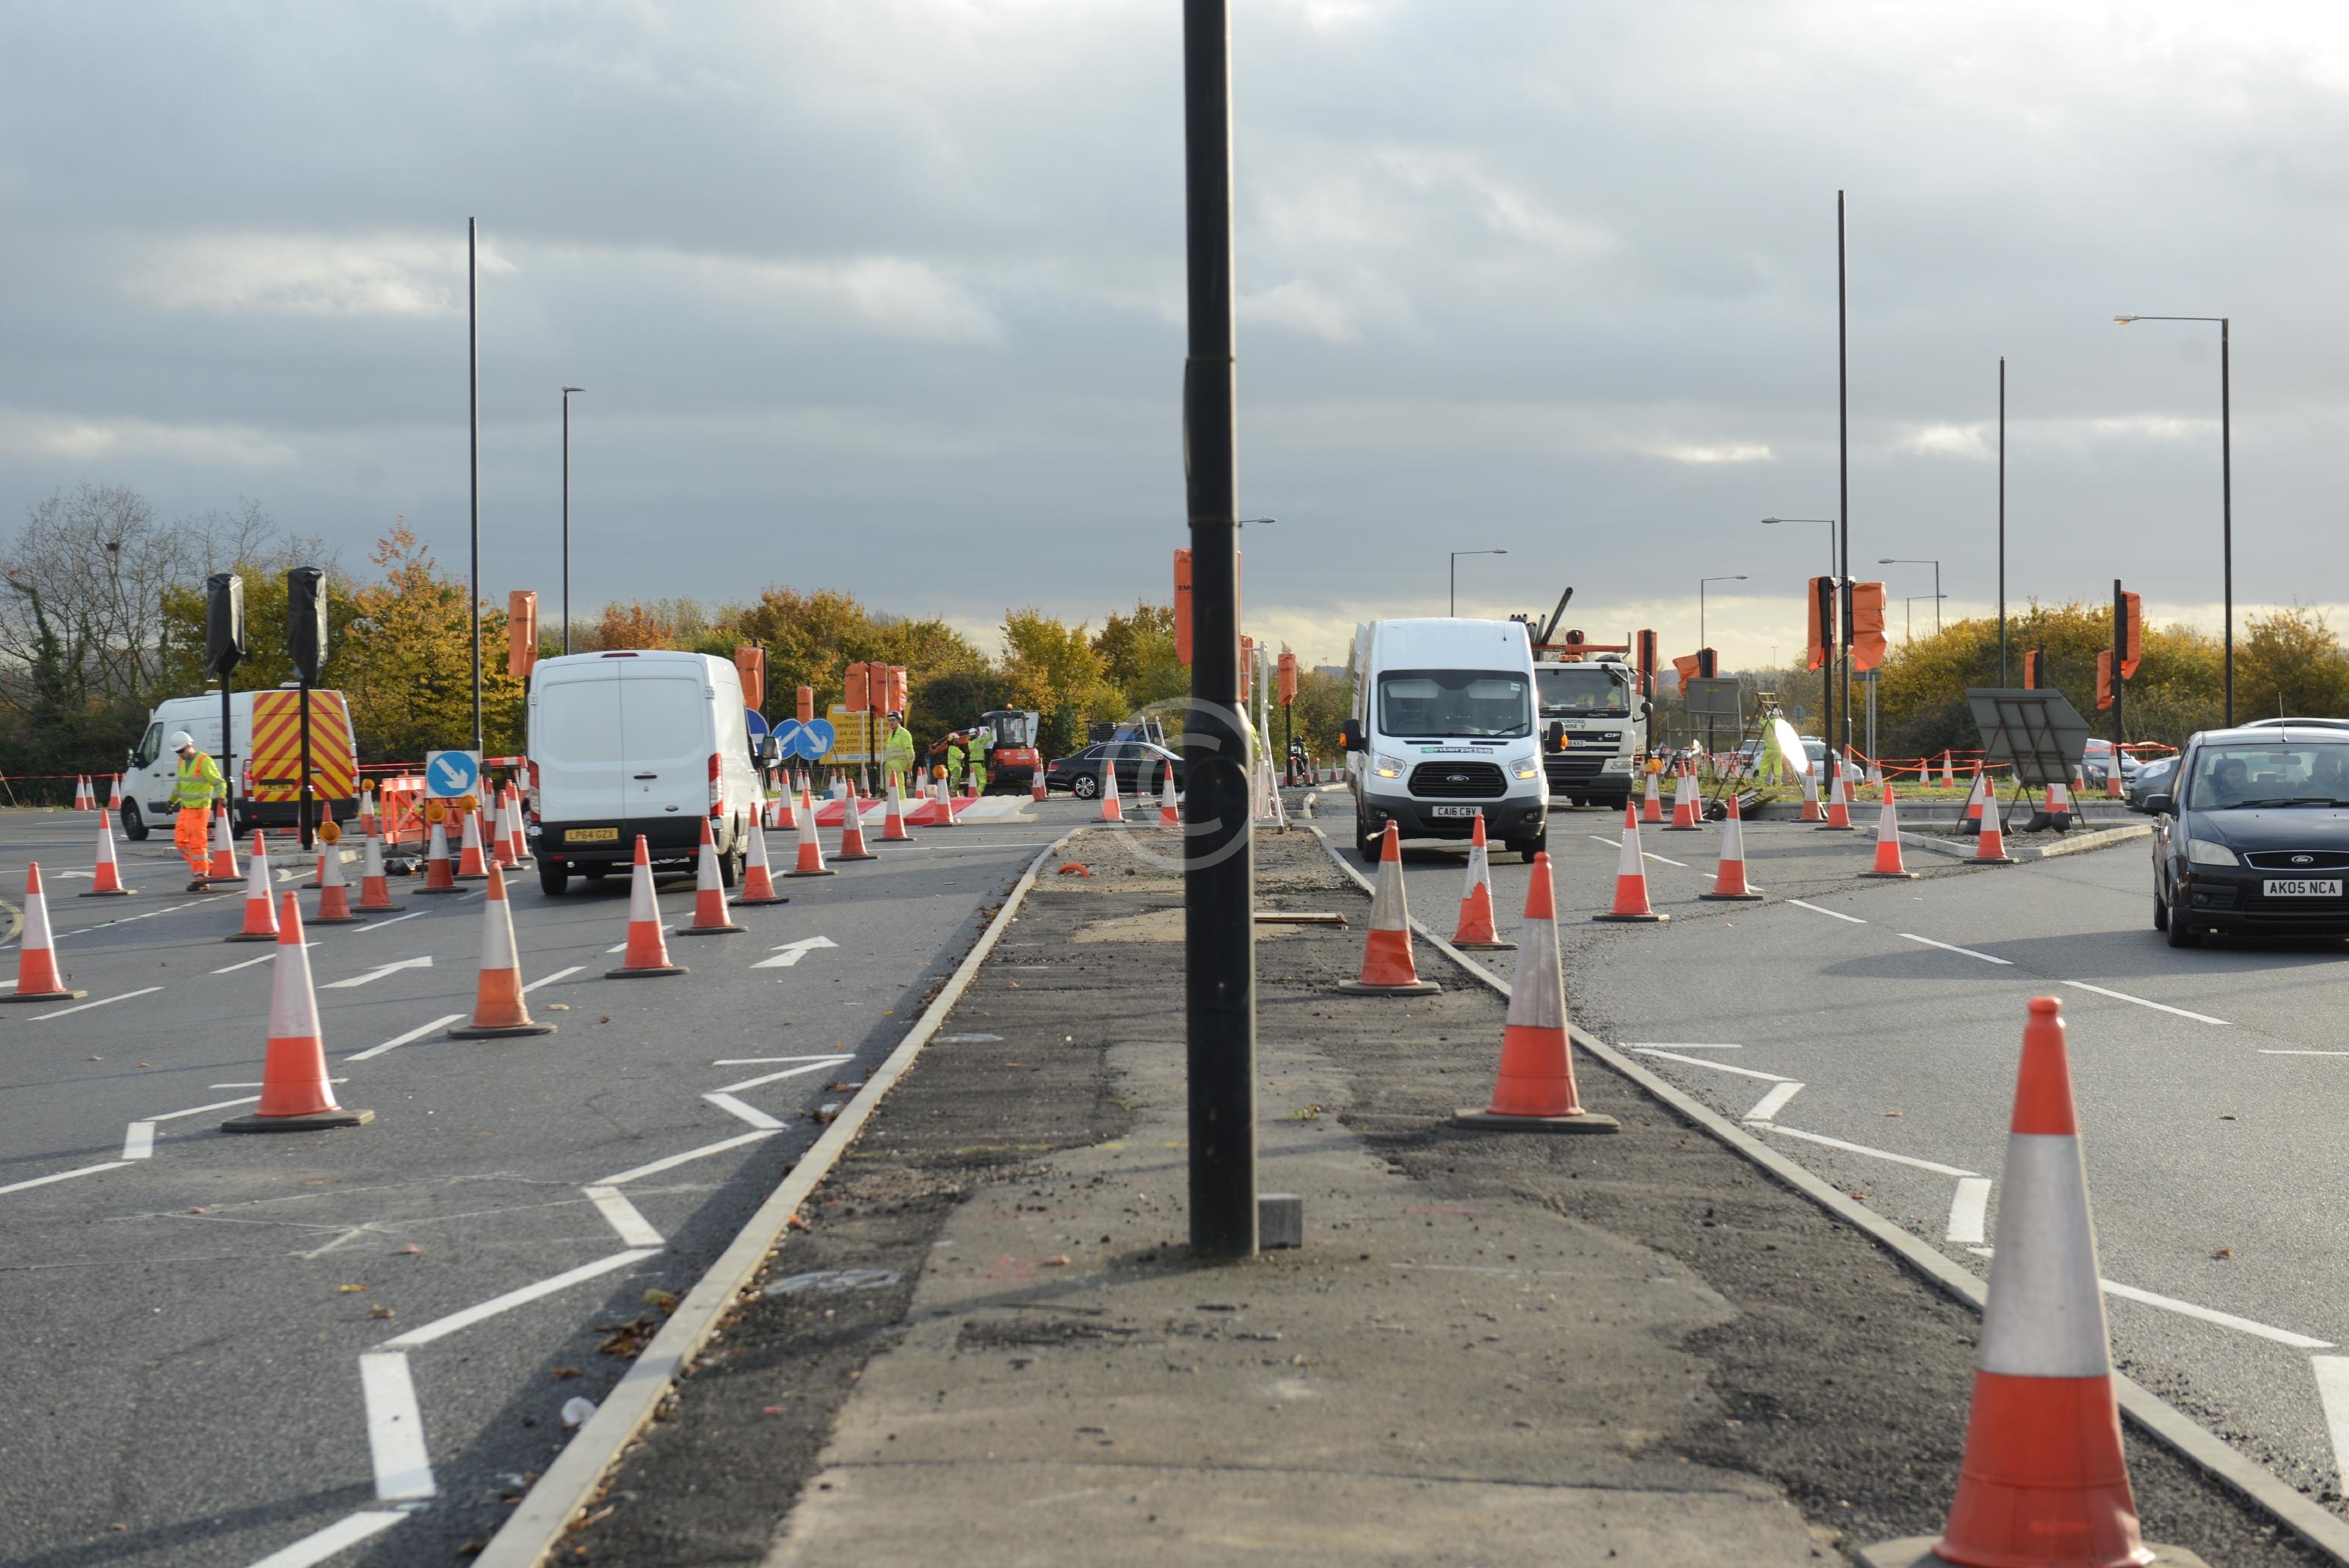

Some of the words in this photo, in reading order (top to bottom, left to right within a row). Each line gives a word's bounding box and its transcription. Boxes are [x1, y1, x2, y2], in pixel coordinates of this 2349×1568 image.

[1421, 747, 1493, 755] enterprise
[1437, 807, 1457, 816] CA16
[1459, 807, 1477, 816] CBV
[570, 831, 593, 840] LP64
[596, 830, 614, 839] GZX
[2270, 882, 2306, 894] AK05
[2309, 882, 2336, 894] NCA
